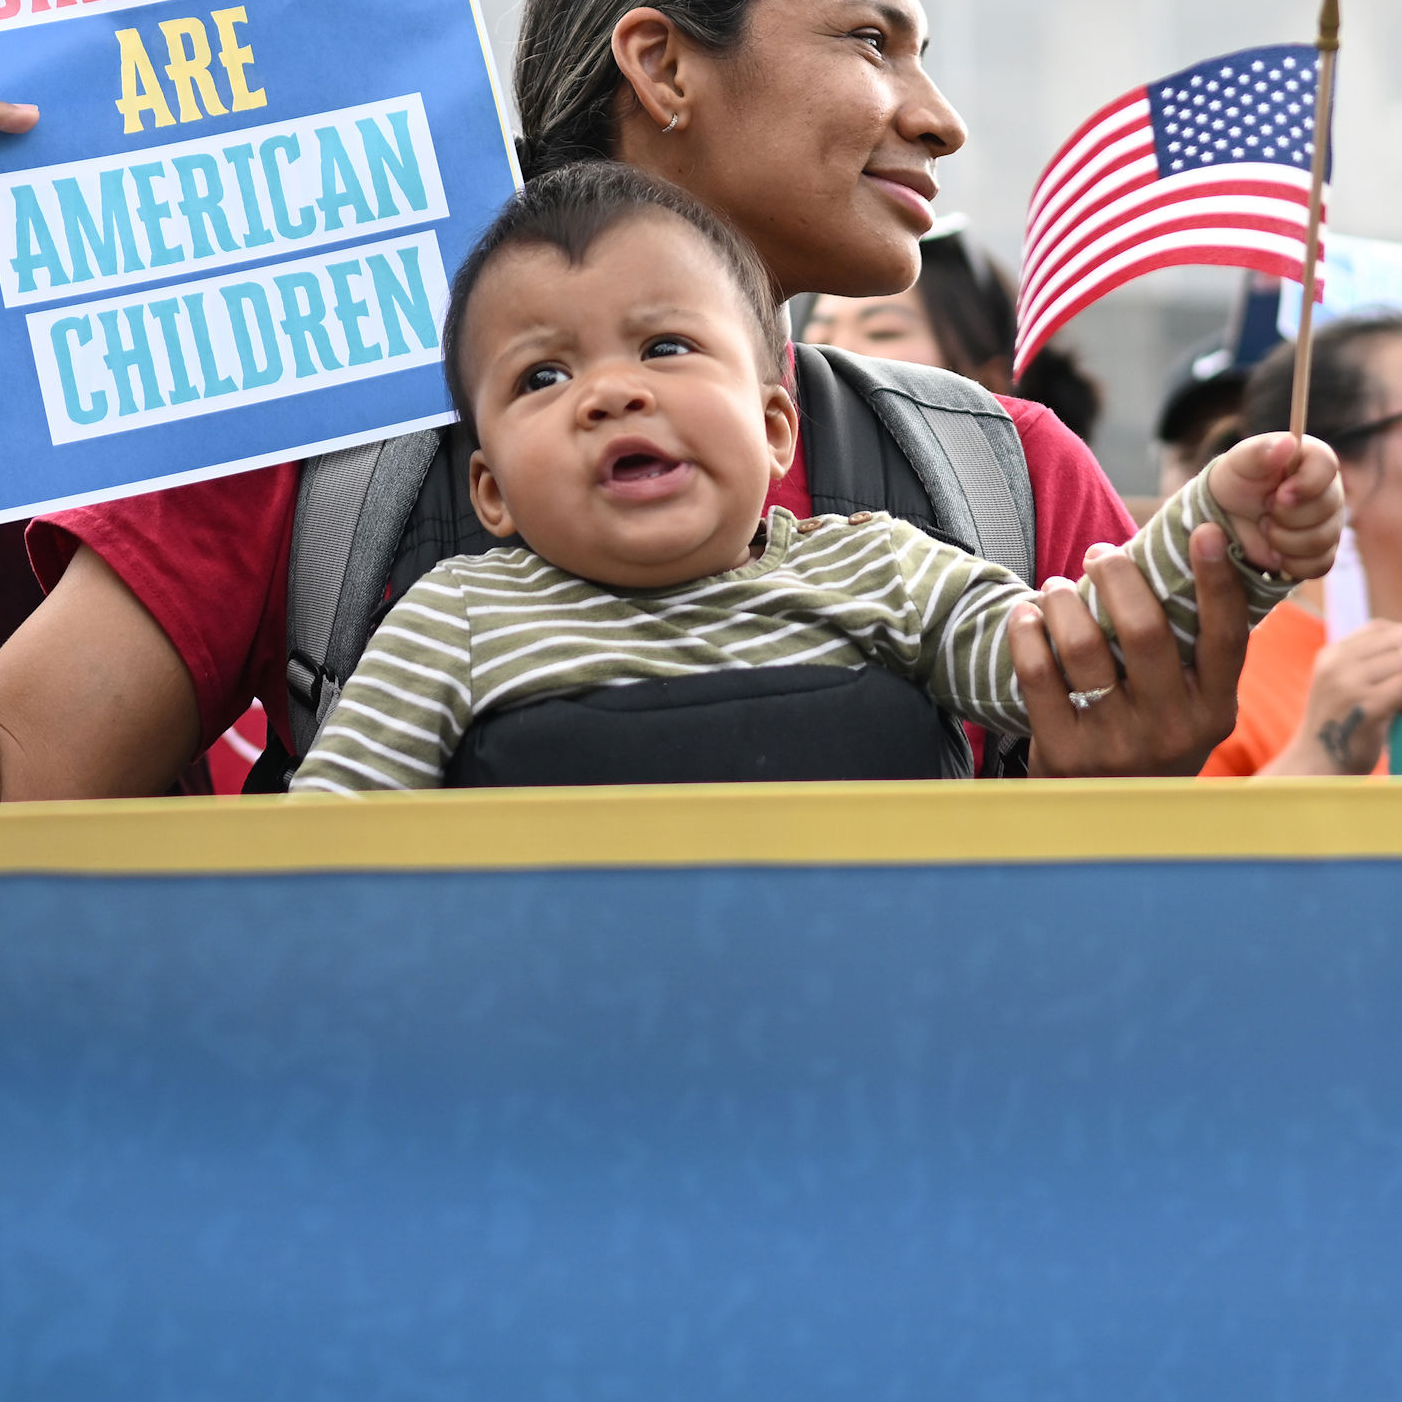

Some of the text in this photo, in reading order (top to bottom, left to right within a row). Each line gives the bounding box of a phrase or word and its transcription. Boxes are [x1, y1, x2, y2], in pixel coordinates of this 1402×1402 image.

[117, 7, 266, 132] ARE
[11, 110, 428, 293] AMERICAN
[51, 247, 439, 424] CHILDREN
